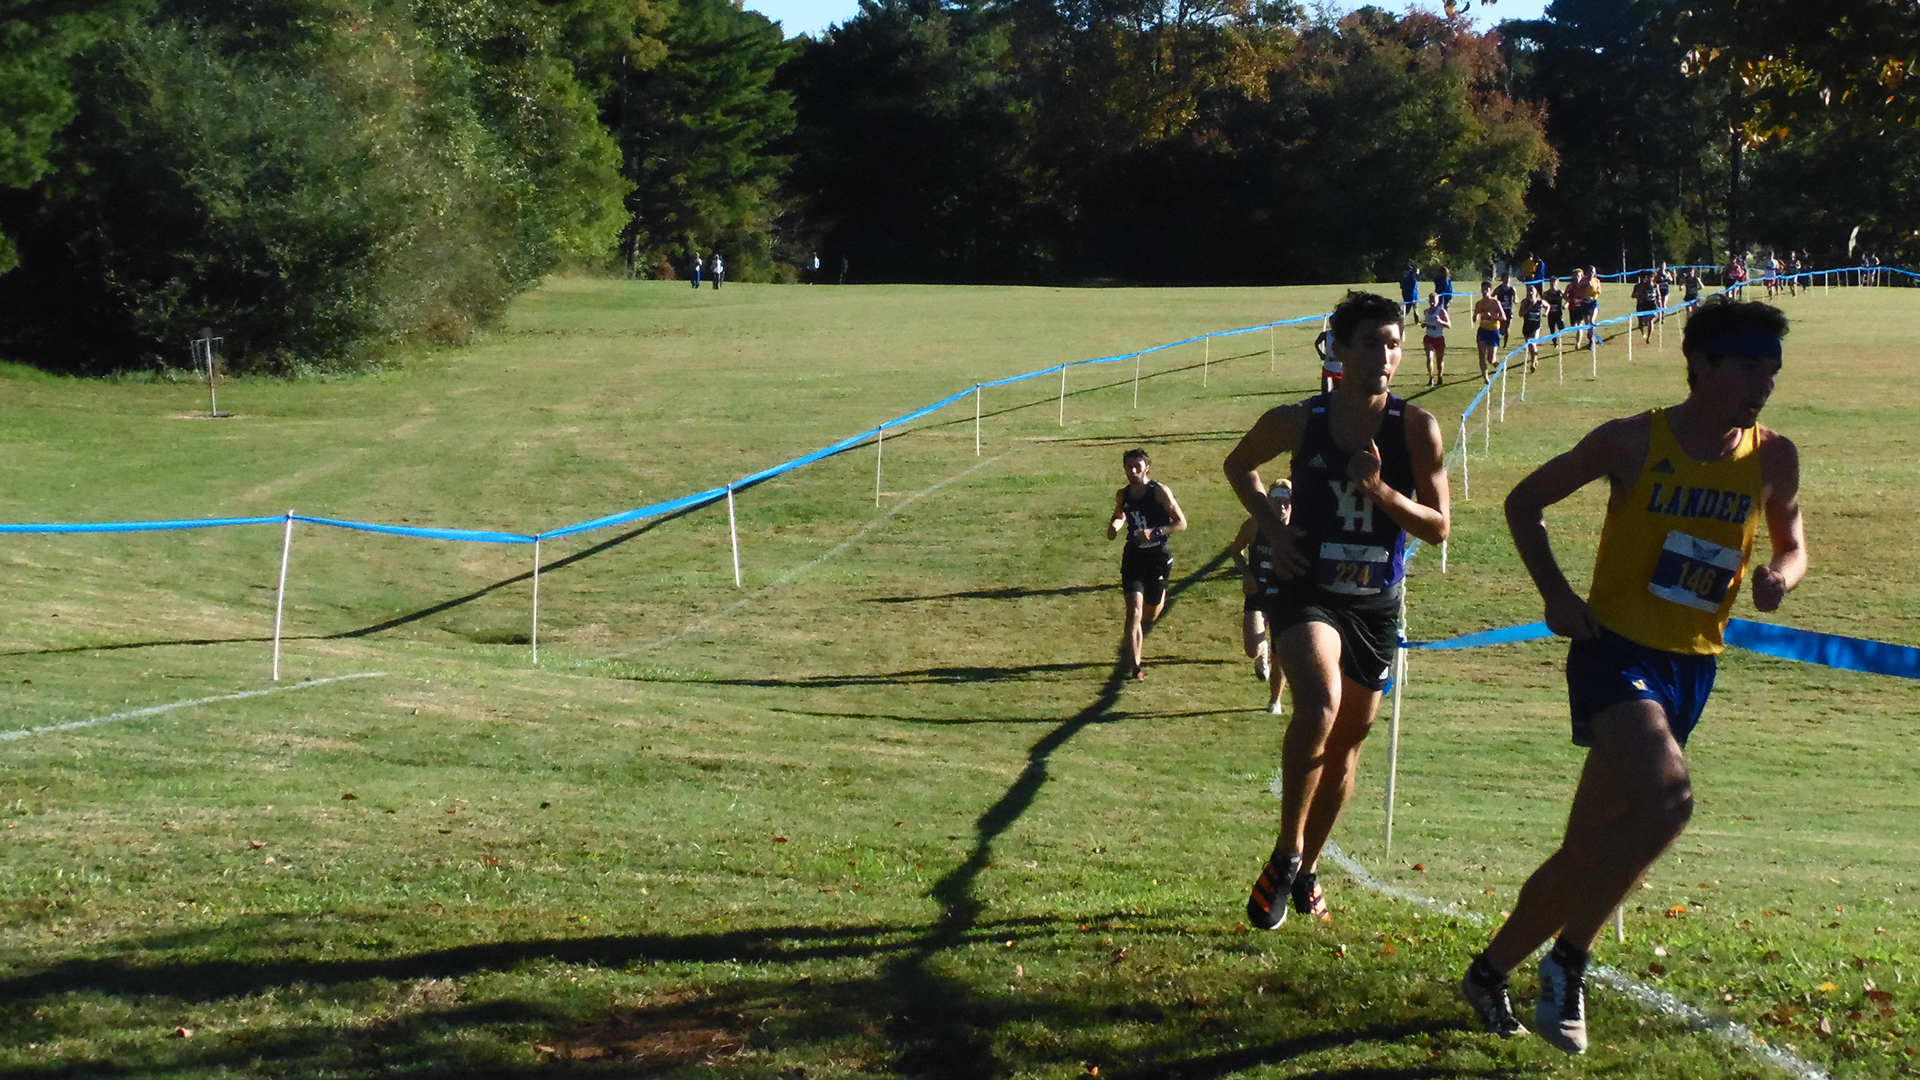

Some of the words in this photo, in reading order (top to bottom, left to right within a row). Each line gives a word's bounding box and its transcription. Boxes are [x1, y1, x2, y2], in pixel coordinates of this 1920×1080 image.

[1648, 483, 1752, 524] LANDER
[1335, 563, 1370, 584] 224
[1678, 561, 1717, 596] 146
